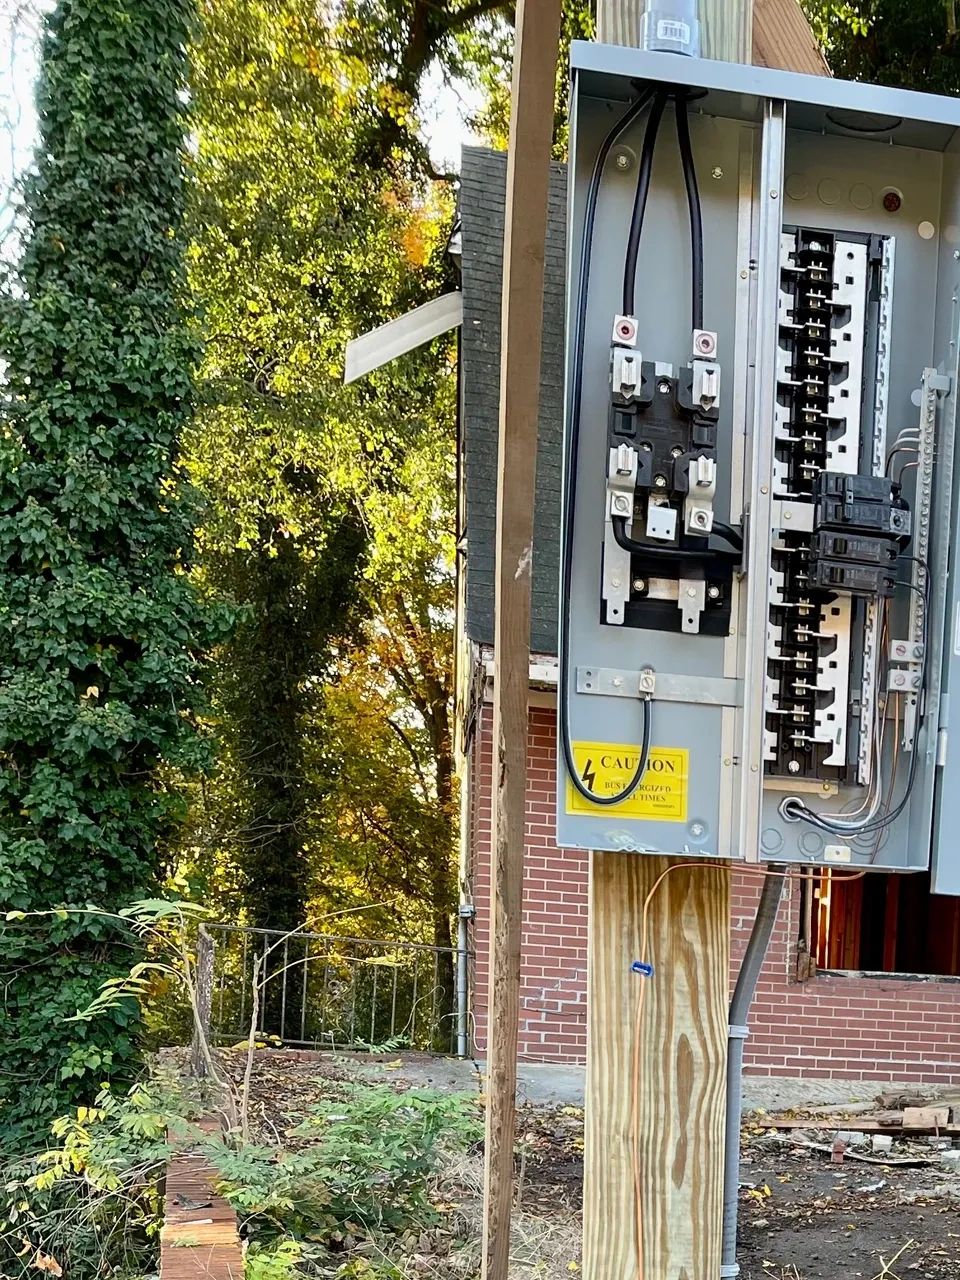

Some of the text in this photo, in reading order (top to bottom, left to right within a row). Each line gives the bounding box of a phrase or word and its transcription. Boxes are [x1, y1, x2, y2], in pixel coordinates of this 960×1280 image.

[601, 755, 674, 773] CAUION
[605, 781, 621, 790] BUS
[623, 783, 671, 793] ERGIZED
[640, 794, 666, 802] TIMES
